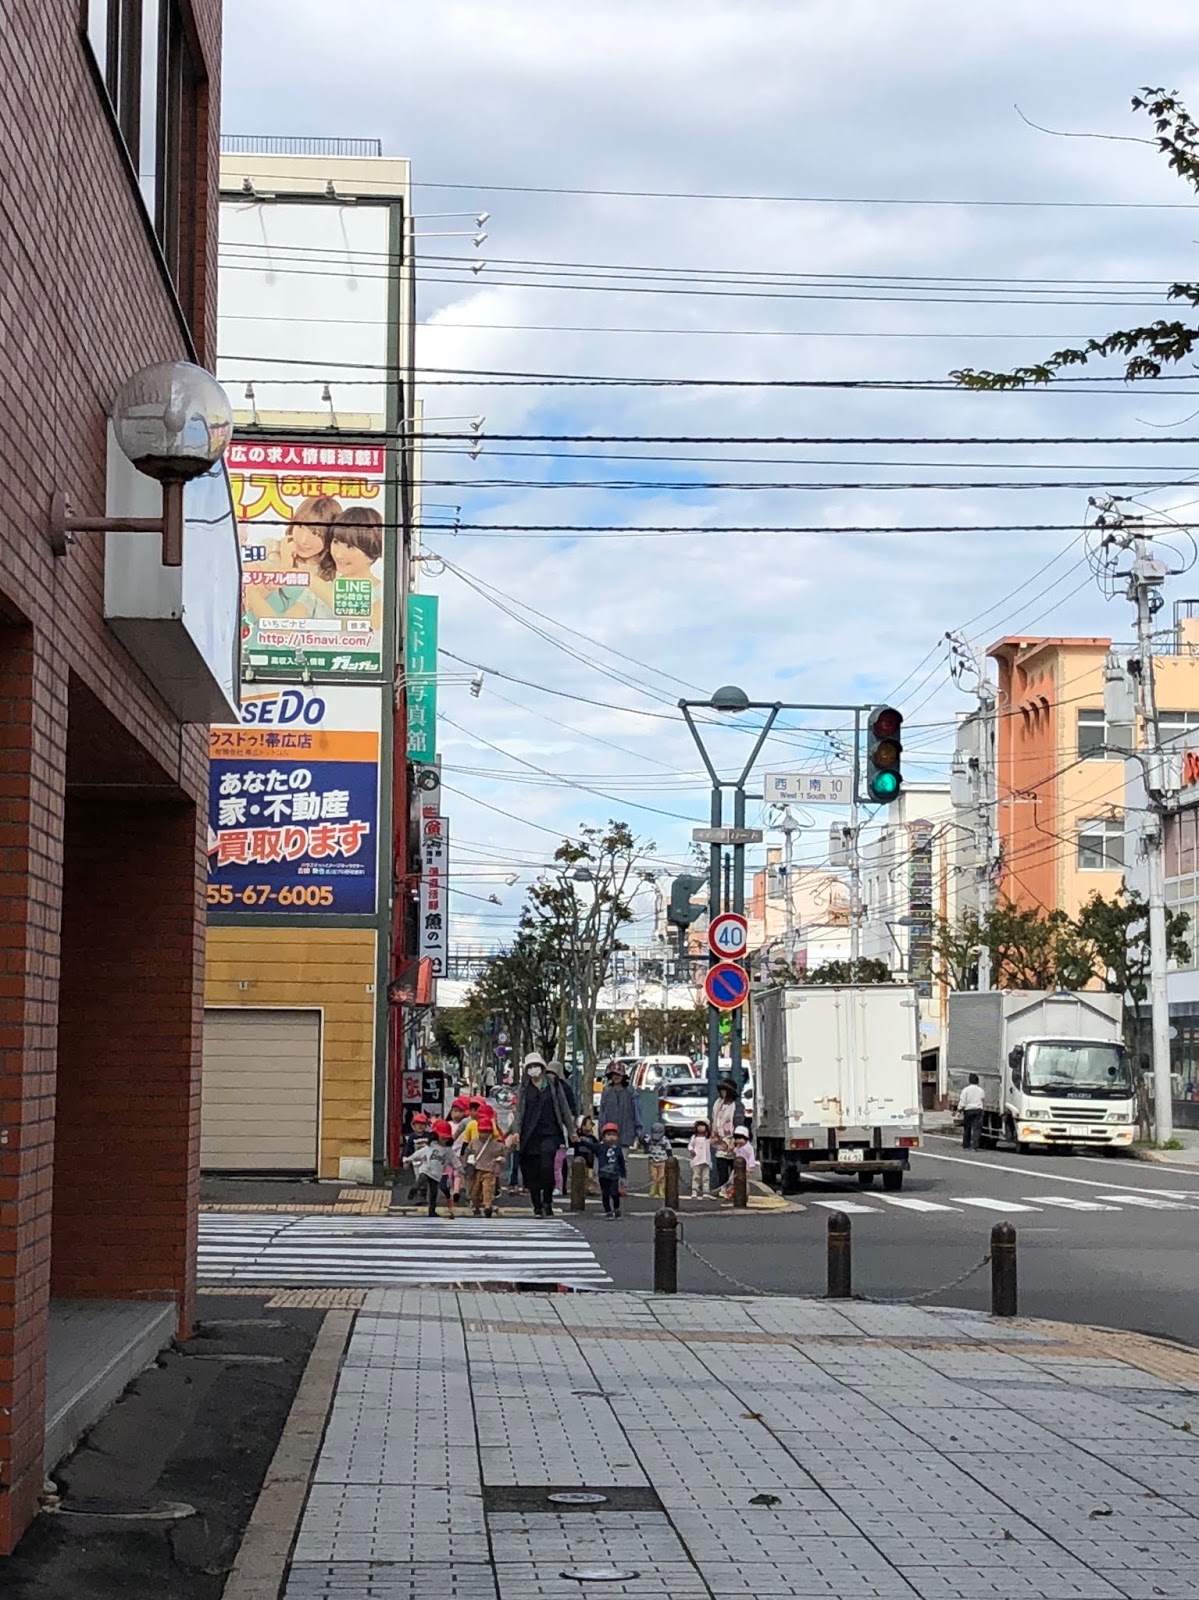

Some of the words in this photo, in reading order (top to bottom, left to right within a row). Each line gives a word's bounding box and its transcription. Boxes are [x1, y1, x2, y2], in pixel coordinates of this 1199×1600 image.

[335, 580, 370, 592] LINE
[262, 620, 307, 629] いちごナビ
[258, 632, 372, 647] http://15navi.com/
[407, 606, 428, 753] ミドリ写真館
[238, 690, 326, 725] SEDO
[218, 768, 312, 795] あなたの
[806, 792, 826, 800] South
[218, 789, 350, 827] 家・不動産
[216, 820, 370, 868] 買取ります
[719, 926, 742, 946] 40
